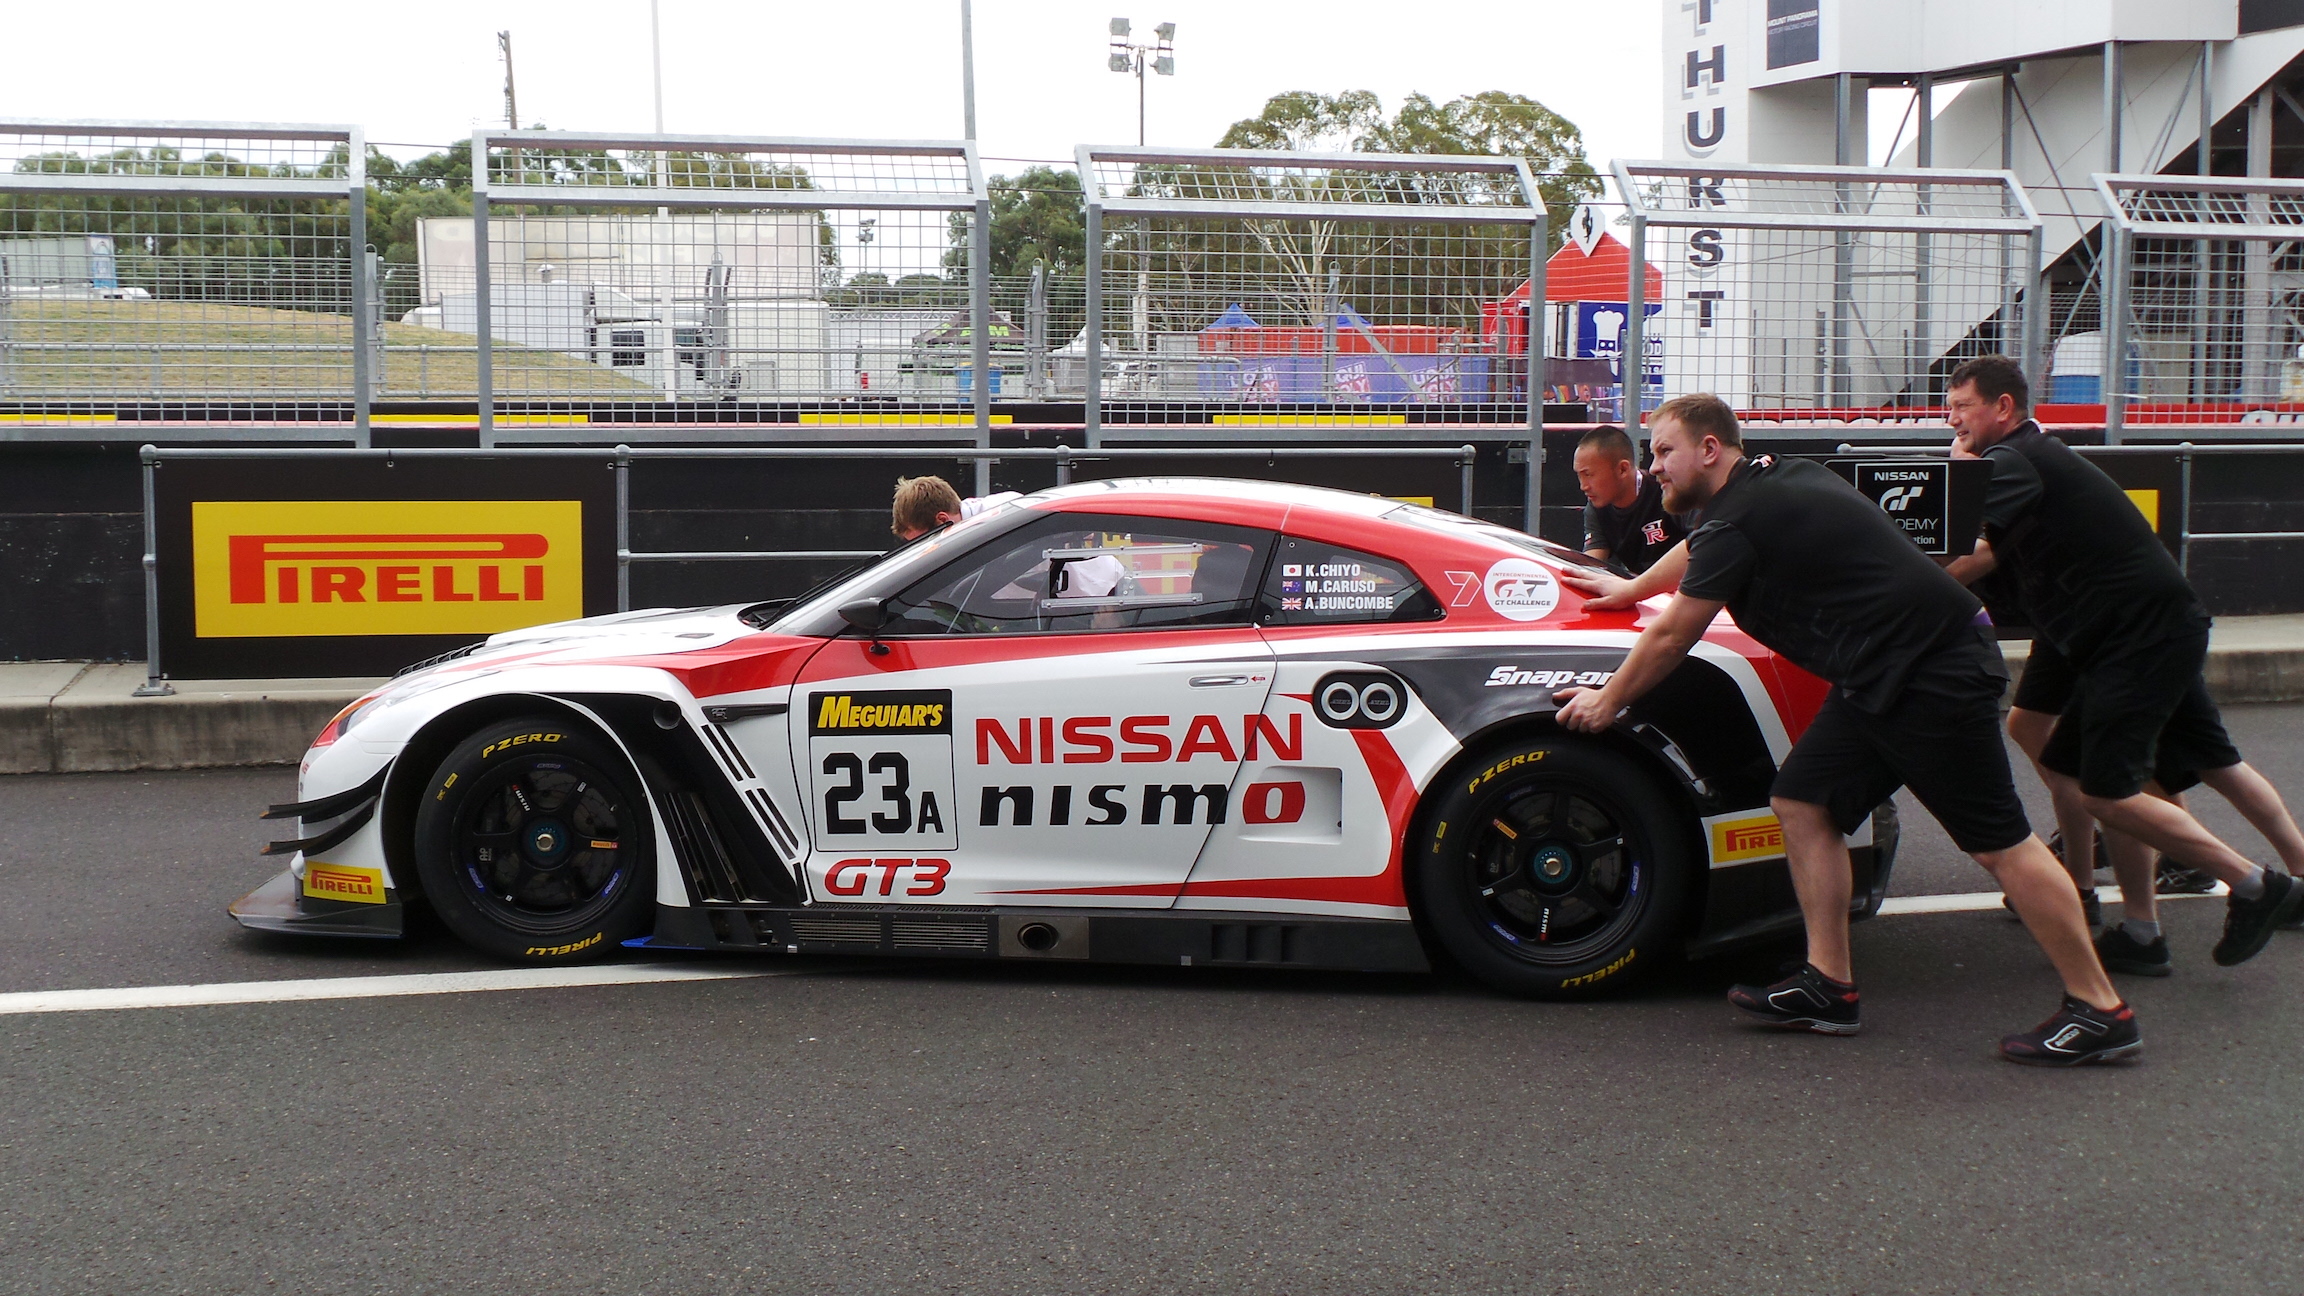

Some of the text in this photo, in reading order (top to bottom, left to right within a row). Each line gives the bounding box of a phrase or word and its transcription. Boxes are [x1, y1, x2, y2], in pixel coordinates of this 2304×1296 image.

[1874, 471, 1929, 481] NISSAN
[1896, 518, 1939, 531] DEMY
[228, 533, 549, 604] PIRELLI
[1305, 564, 1361, 577] K.CHIYO
[1305, 580, 1376, 593] M.CARUSO
[1304, 596, 1394, 610] A.BUNCOMBE
[976, 713, 1303, 765] NISSAN
[1725, 822, 1782, 853] PIRE
[310, 869, 373, 895] PIRELLI
[824, 858, 952, 897] GT3
[525, 932, 603, 956] PIRELLI
[1560, 948, 1636, 988] PIRELLI
